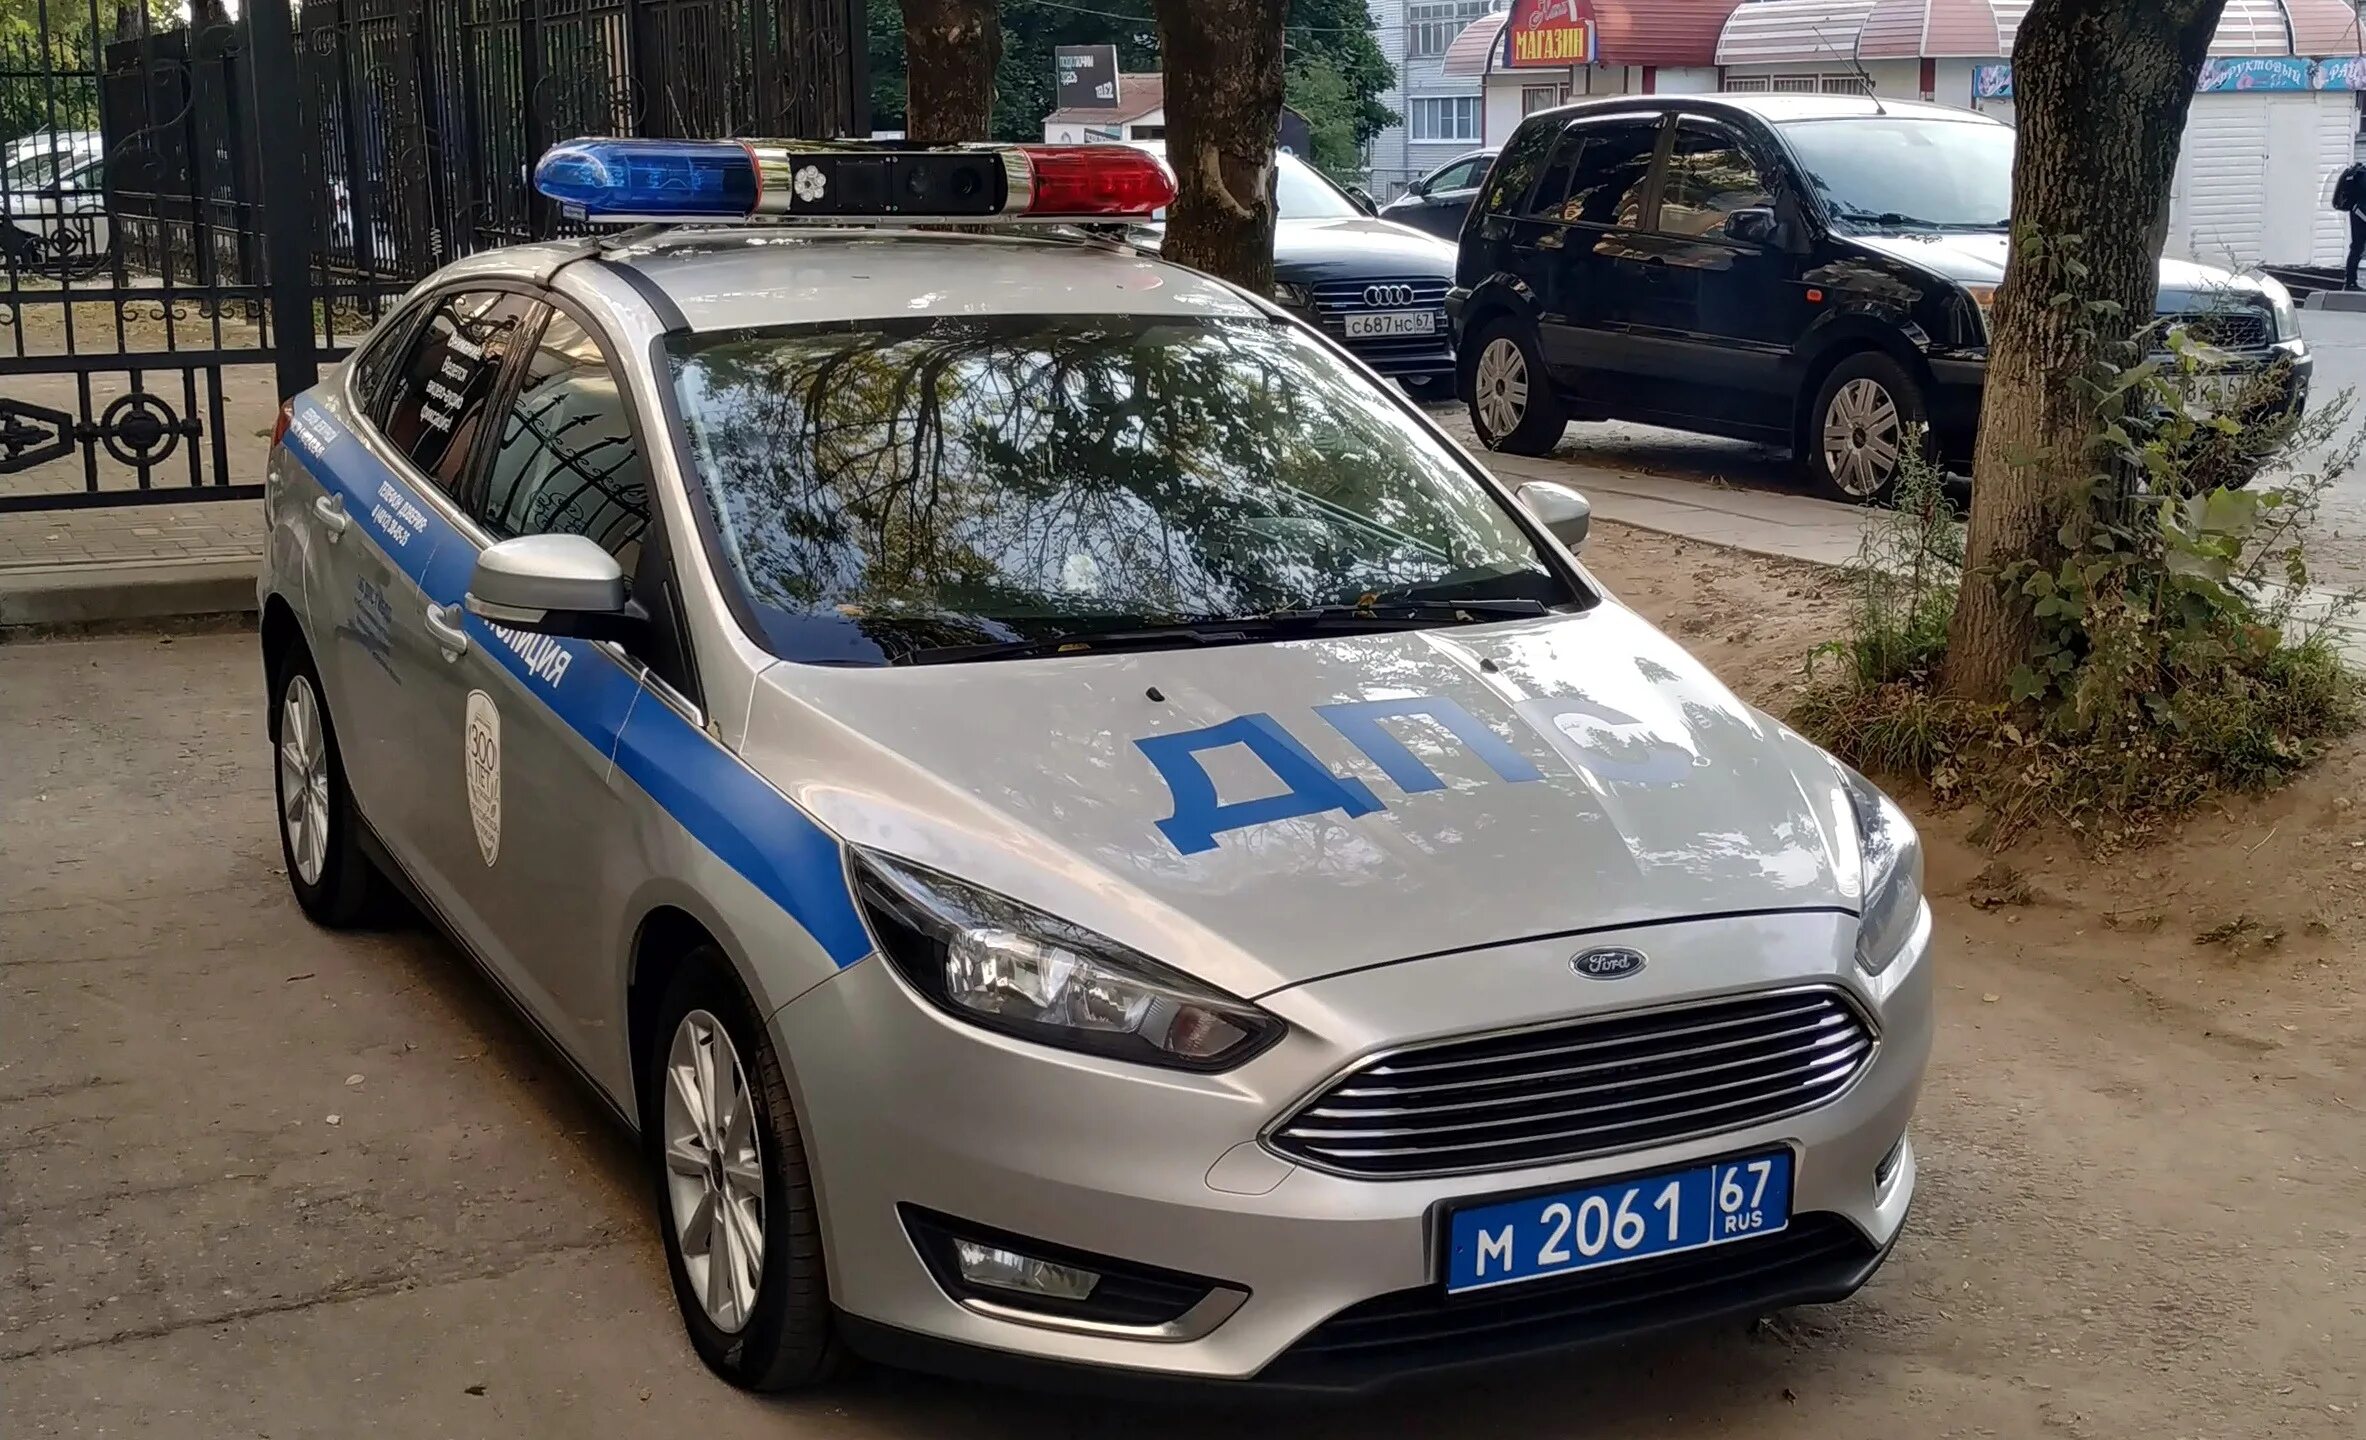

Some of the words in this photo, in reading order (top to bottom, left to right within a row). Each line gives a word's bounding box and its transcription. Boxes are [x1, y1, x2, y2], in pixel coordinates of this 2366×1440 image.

[1516, 28, 1584, 60] МАГАЗИН
[1416, 314, 1429, 327] 67
[484, 619, 572, 689] ОЛИЦИЯ
[471, 724, 496, 771] 300
[1133, 697, 1694, 856] ДПС
[1589, 953, 1630, 972] Ford
[1537, 1181, 1680, 1265] 2061
[1719, 1160, 1772, 1213] 67
[1725, 1211, 1763, 1233] RUS
